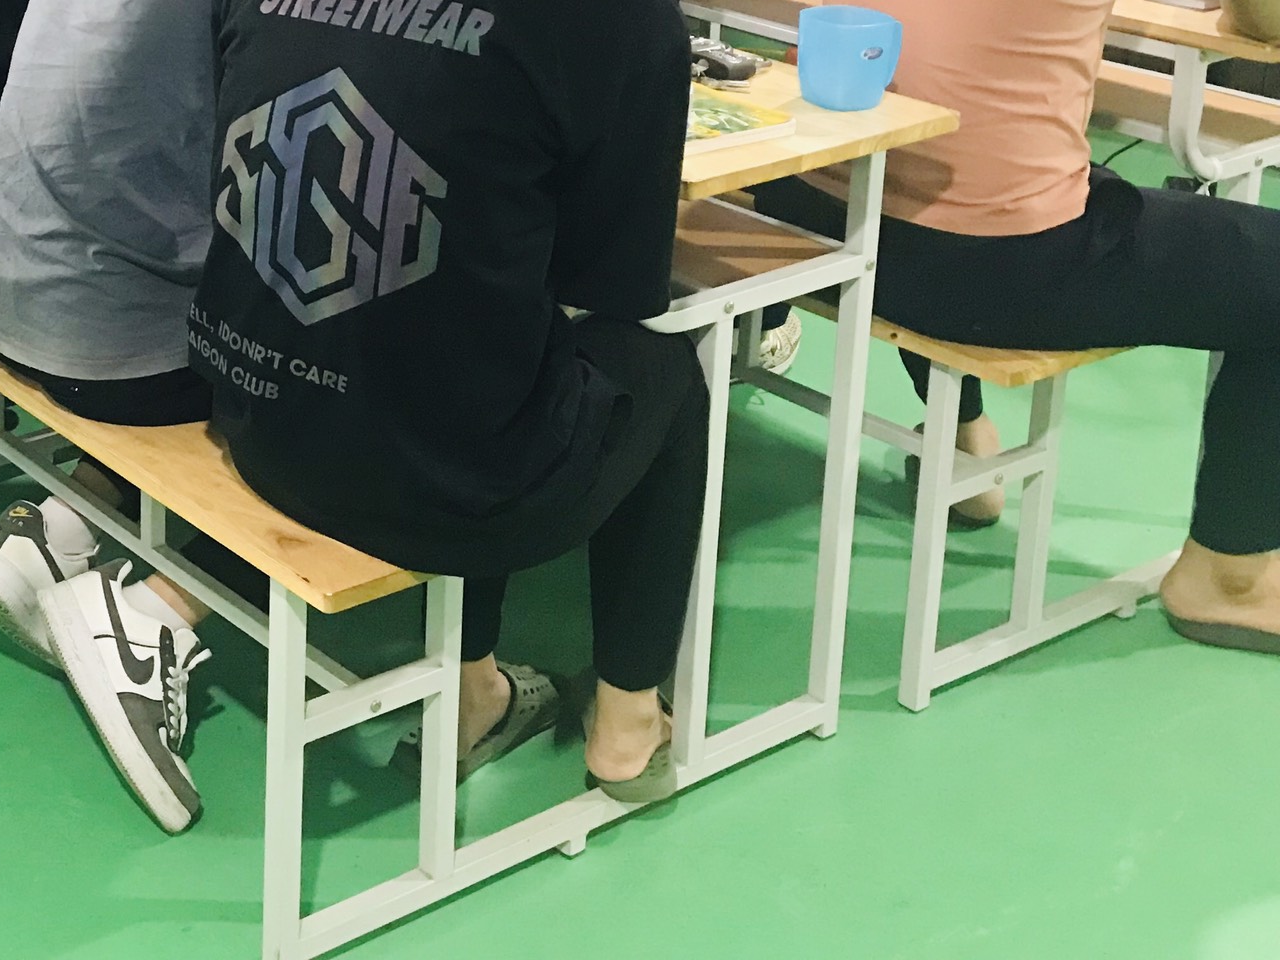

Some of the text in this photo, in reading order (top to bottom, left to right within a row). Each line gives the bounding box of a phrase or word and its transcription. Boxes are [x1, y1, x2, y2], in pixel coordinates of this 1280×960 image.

[188, 329, 280, 400] AIGON CLUB
[189, 302, 214, 333] ELL,
[289, 358, 349, 394] CARE
